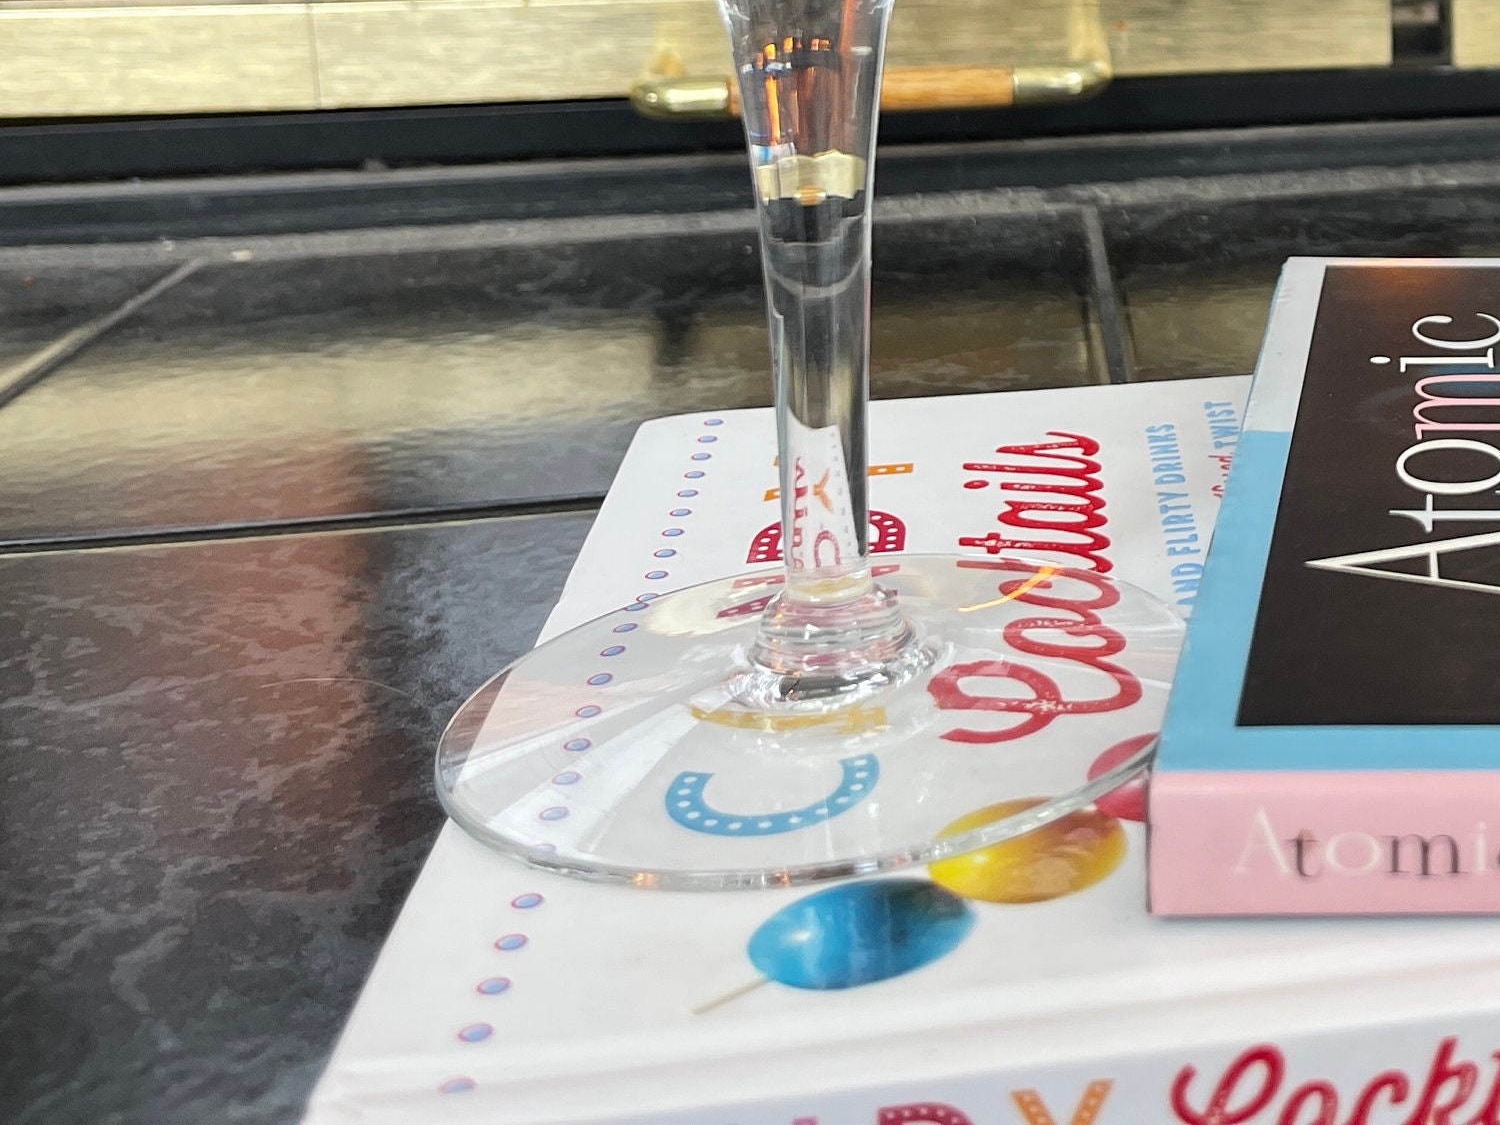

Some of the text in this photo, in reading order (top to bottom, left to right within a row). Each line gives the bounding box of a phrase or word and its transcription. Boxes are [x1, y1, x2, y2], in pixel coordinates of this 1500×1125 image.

[1145, 423, 1187, 485] DRINKS
[1203, 401, 1240, 450] TWIST
[1156, 491, 1202, 557] FLIRTY
[925, 431, 1144, 744] Cocktails
